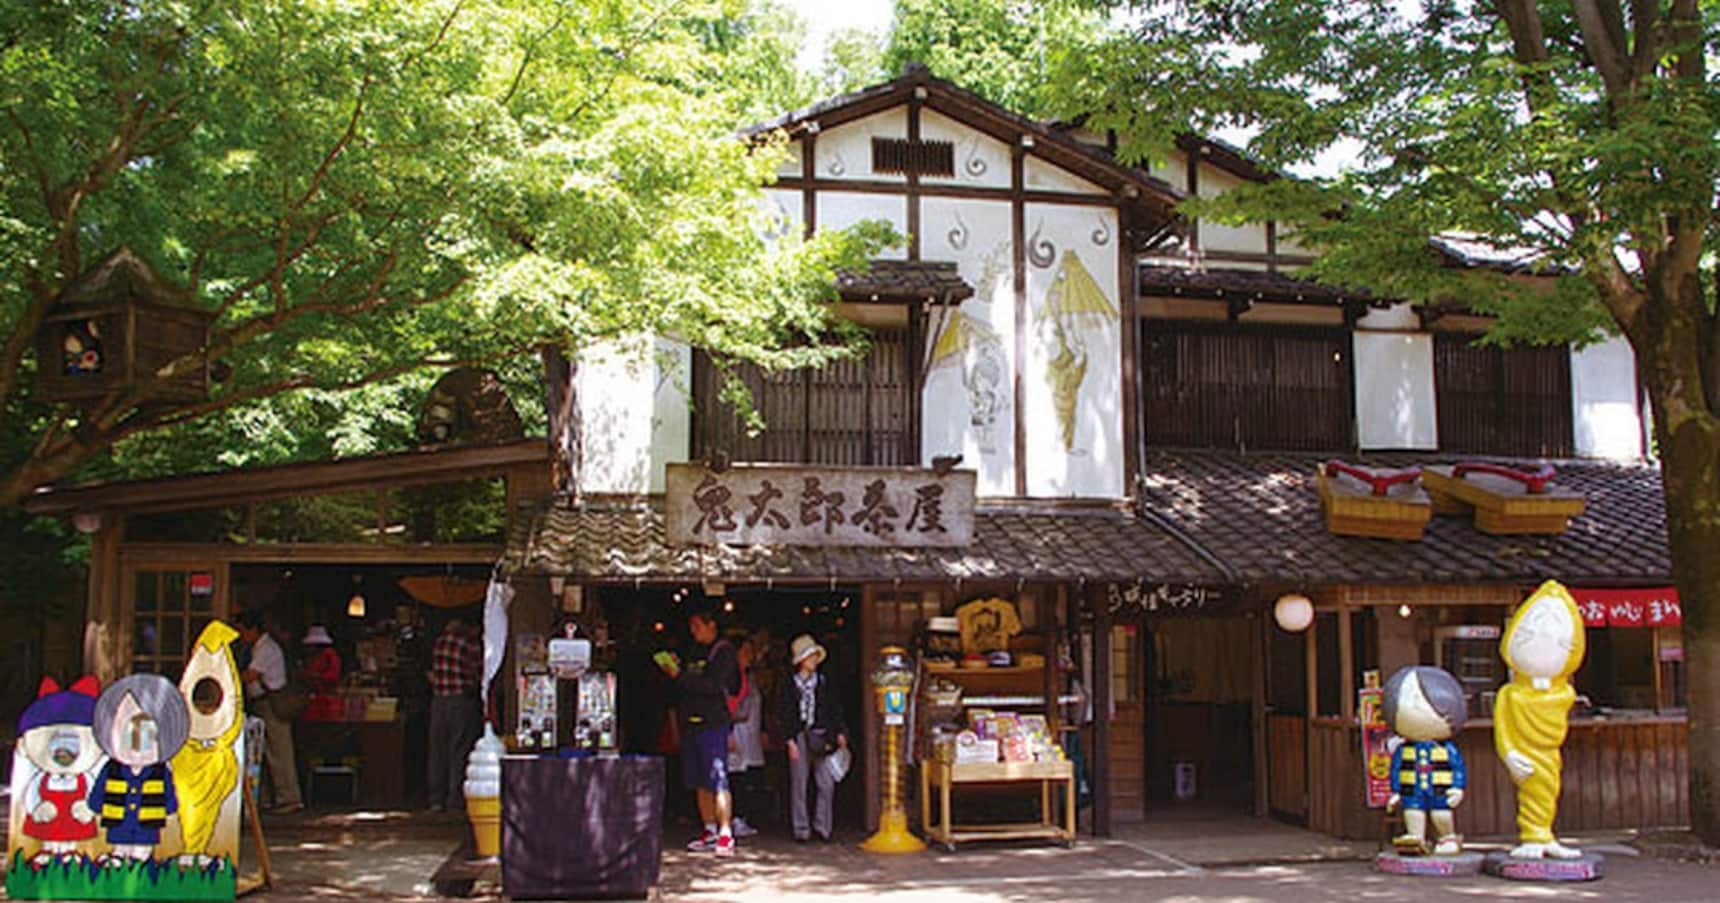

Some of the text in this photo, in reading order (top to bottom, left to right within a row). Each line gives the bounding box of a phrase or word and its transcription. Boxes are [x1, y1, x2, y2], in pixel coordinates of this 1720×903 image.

[692, 476, 948, 535] 鬼太郎茶屋
